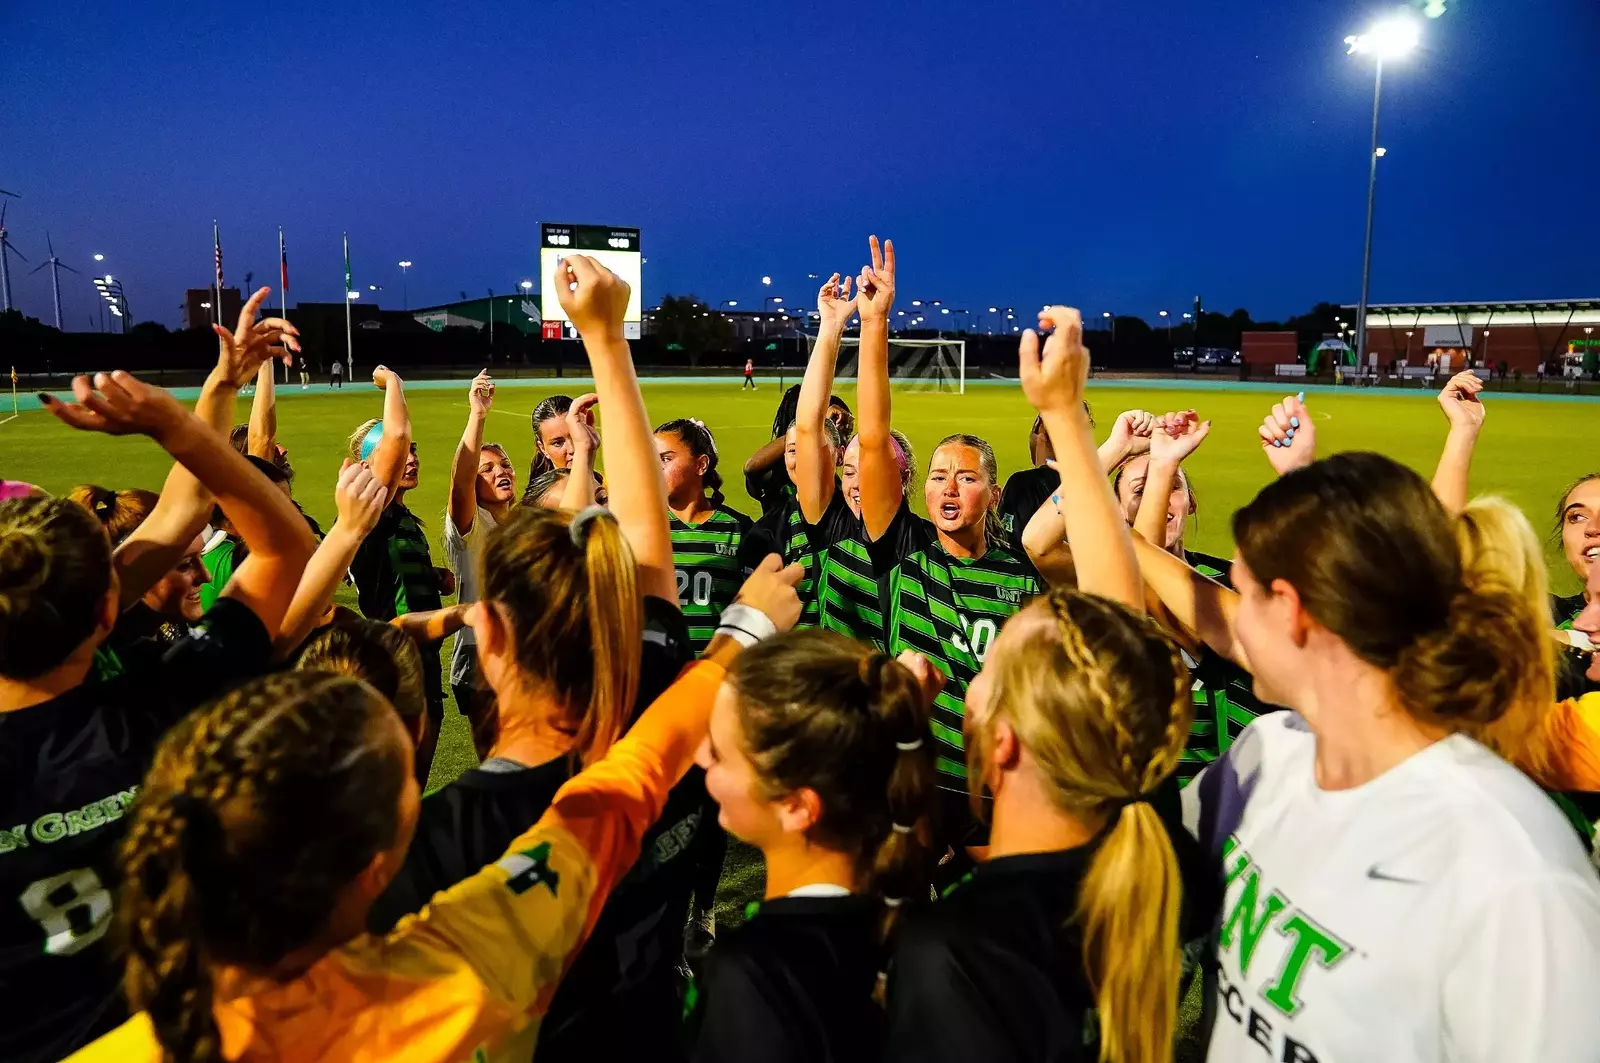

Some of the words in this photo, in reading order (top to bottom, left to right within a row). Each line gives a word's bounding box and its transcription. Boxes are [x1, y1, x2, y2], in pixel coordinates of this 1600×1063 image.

[715, 543, 738, 556] UNT
[674, 569, 712, 606] 20
[995, 586, 1021, 603] UNT
[20, 867, 113, 957] 8
